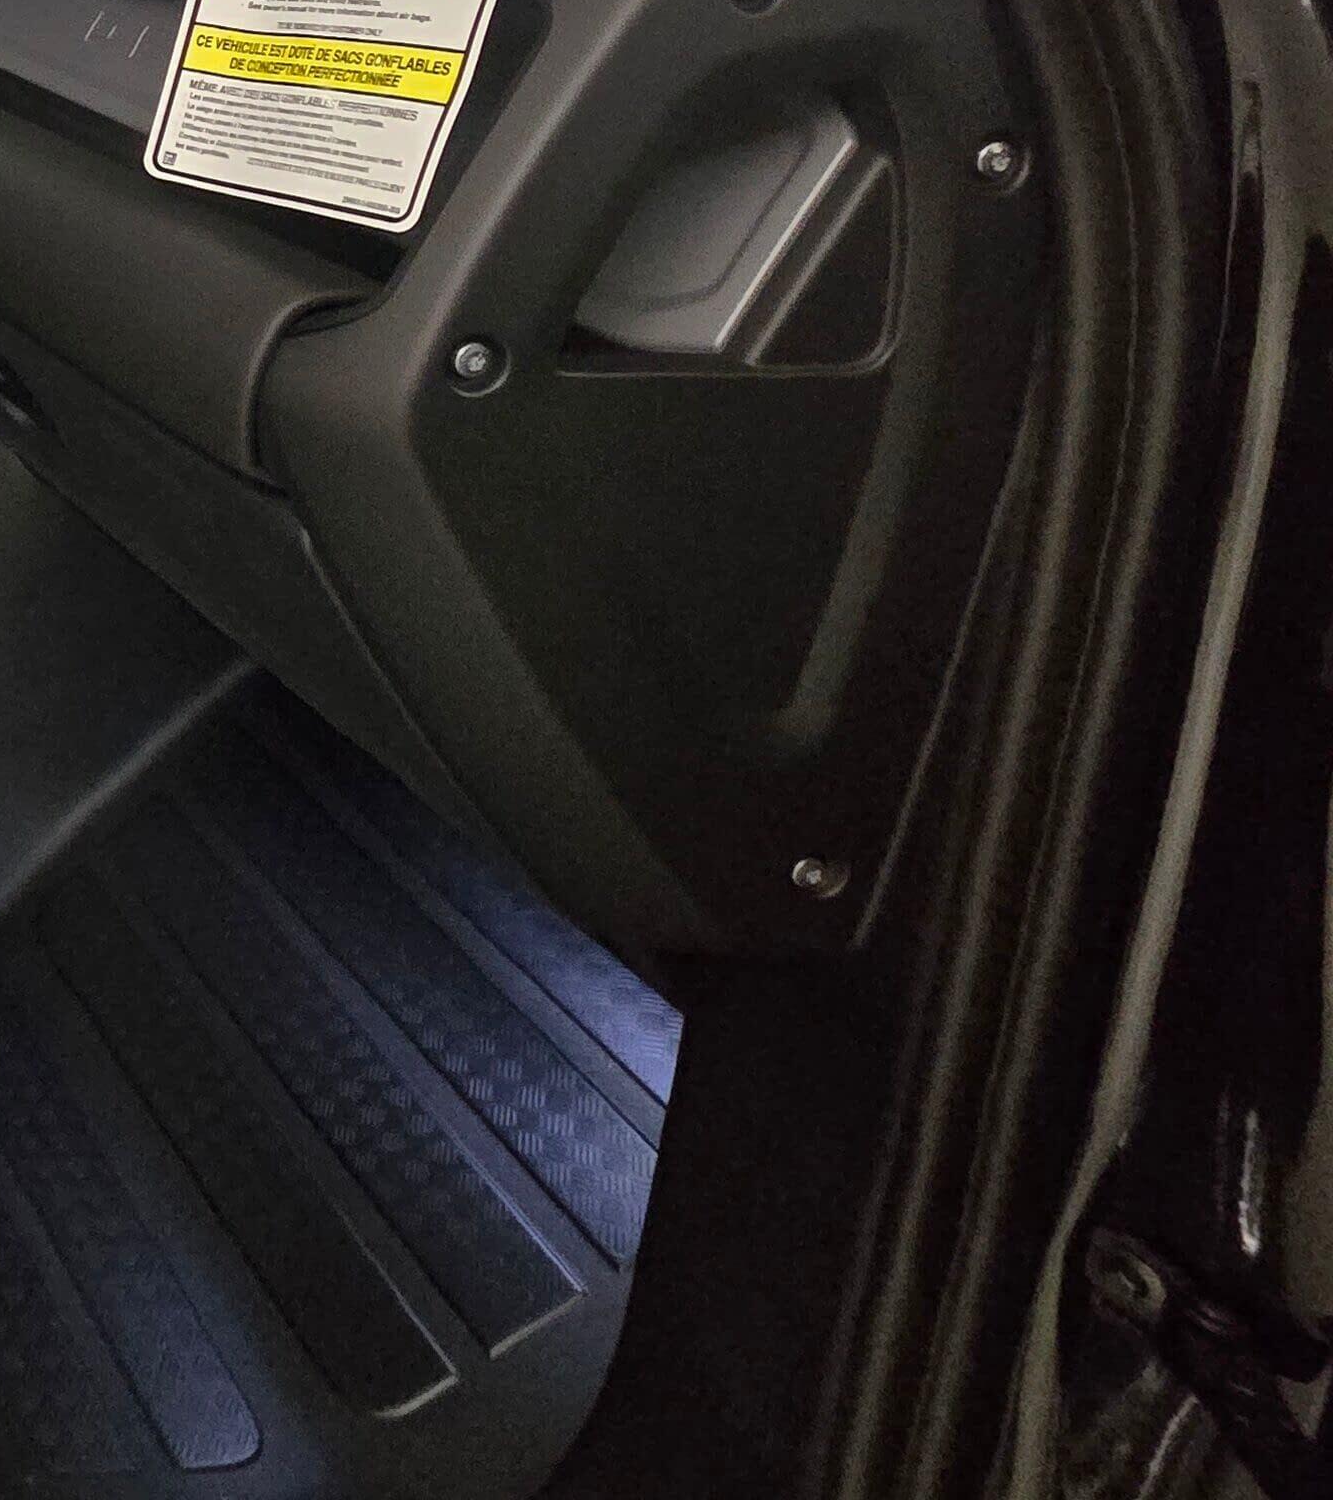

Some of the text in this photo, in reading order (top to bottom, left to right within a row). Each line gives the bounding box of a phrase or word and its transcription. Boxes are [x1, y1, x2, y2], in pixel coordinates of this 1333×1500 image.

[196, 34, 213, 48] CE
[268, 44, 288, 58] EST
[315, 48, 332, 61] DE
[333, 49, 364, 65] SACS
[365, 52, 452, 76] GONFLABLES
[229, 57, 247, 70] DE
[246, 60, 309, 77] CONCEPTION
